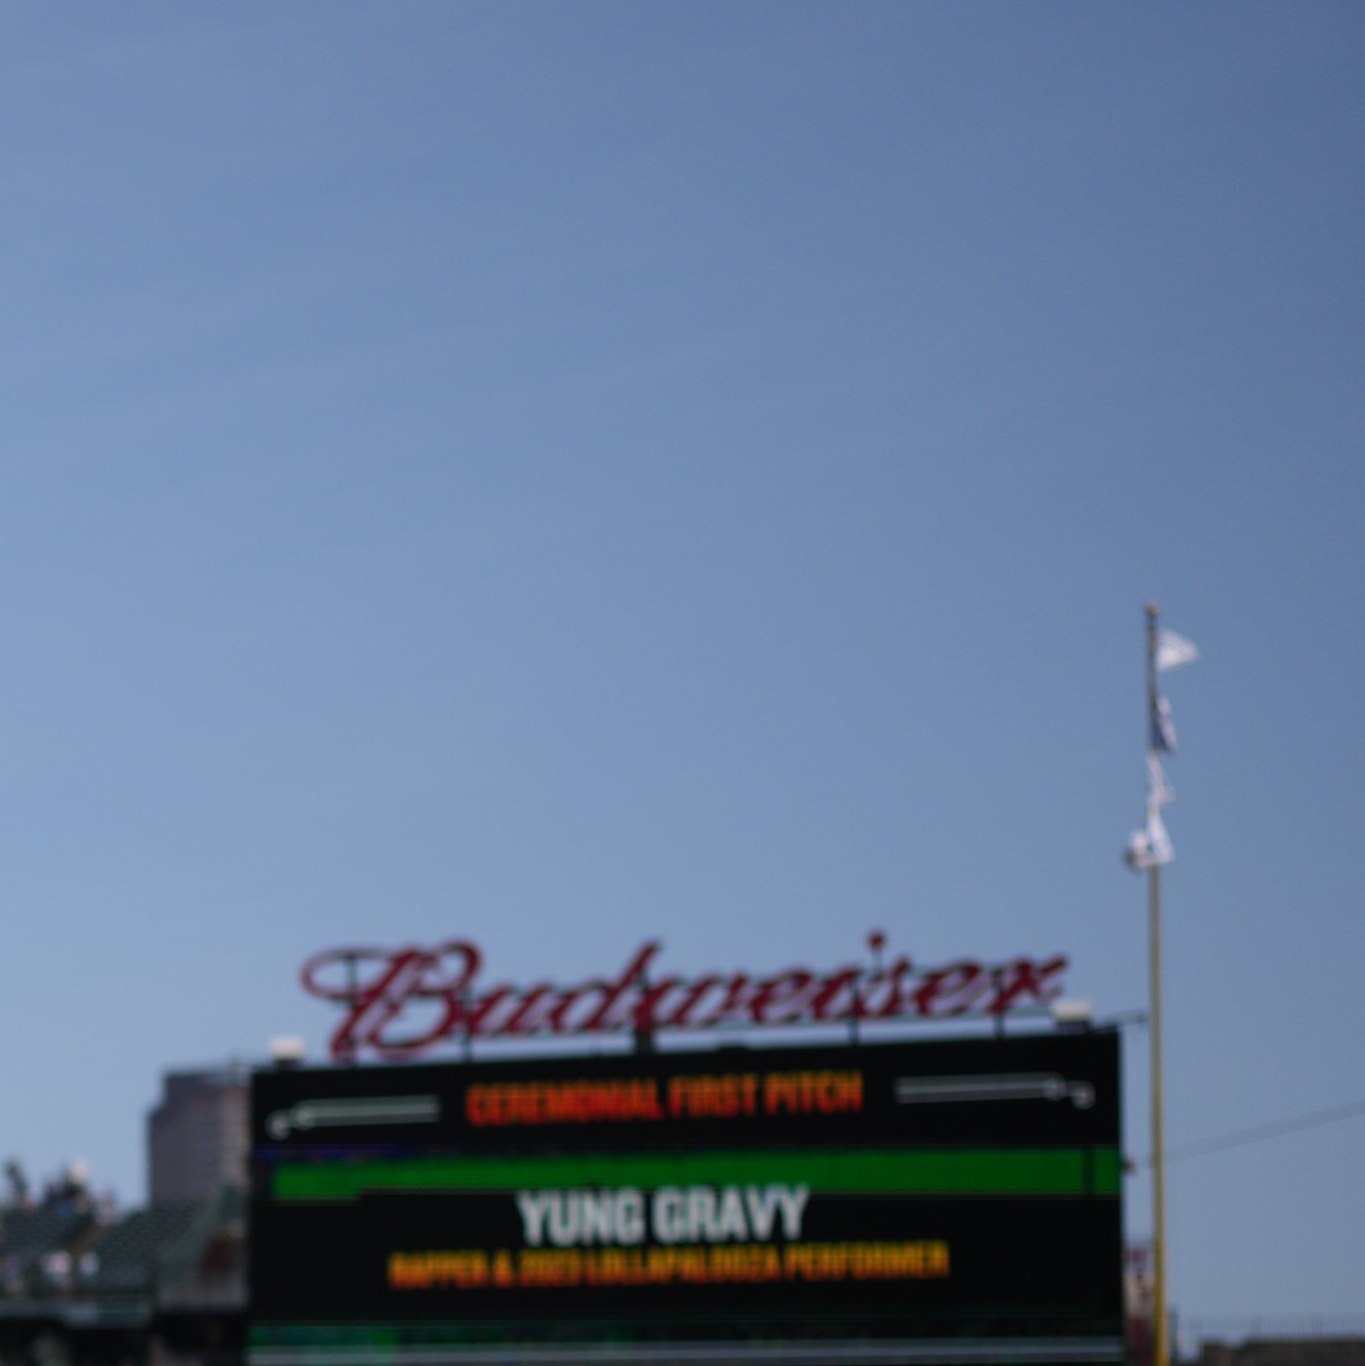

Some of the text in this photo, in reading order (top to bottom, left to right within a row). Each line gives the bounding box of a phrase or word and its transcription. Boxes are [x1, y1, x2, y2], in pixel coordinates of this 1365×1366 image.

[301, 930, 1068, 1063] Budweiser
[669, 1074, 758, 1118] FIRST
[763, 1069, 863, 1114] PITCH
[517, 1183, 810, 1247] YUNG GRAVY
